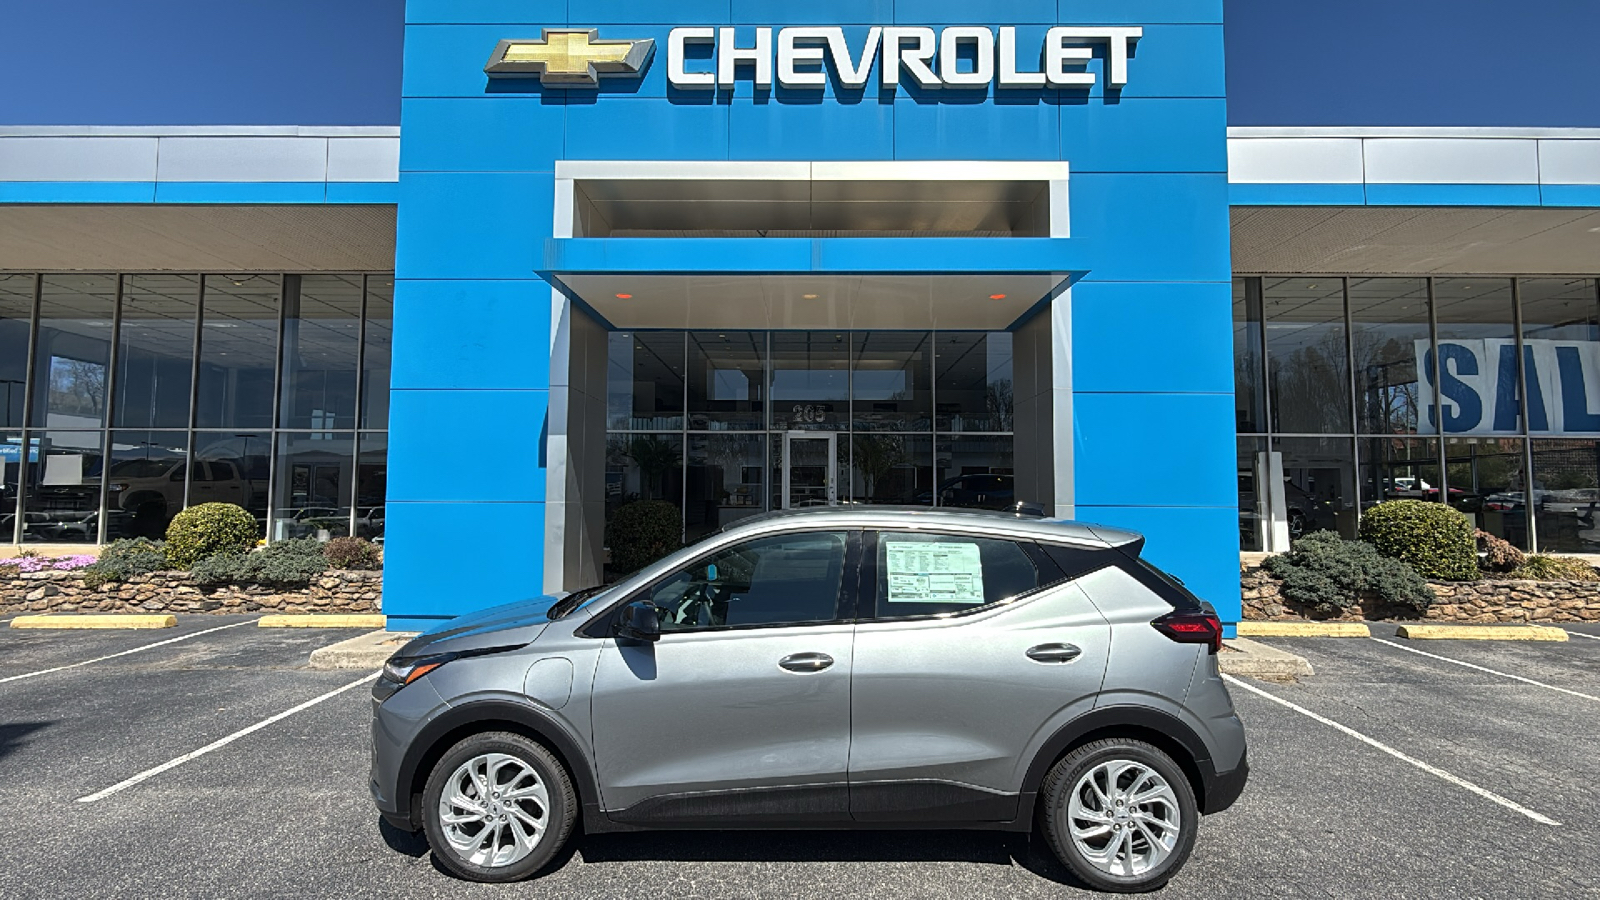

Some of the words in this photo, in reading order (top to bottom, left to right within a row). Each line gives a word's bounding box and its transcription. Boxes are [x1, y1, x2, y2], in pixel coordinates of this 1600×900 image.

[667, 26, 1143, 89] CHEVROLET
[792, 404, 826, 422] 205
[1424, 343, 1600, 432] SAL
